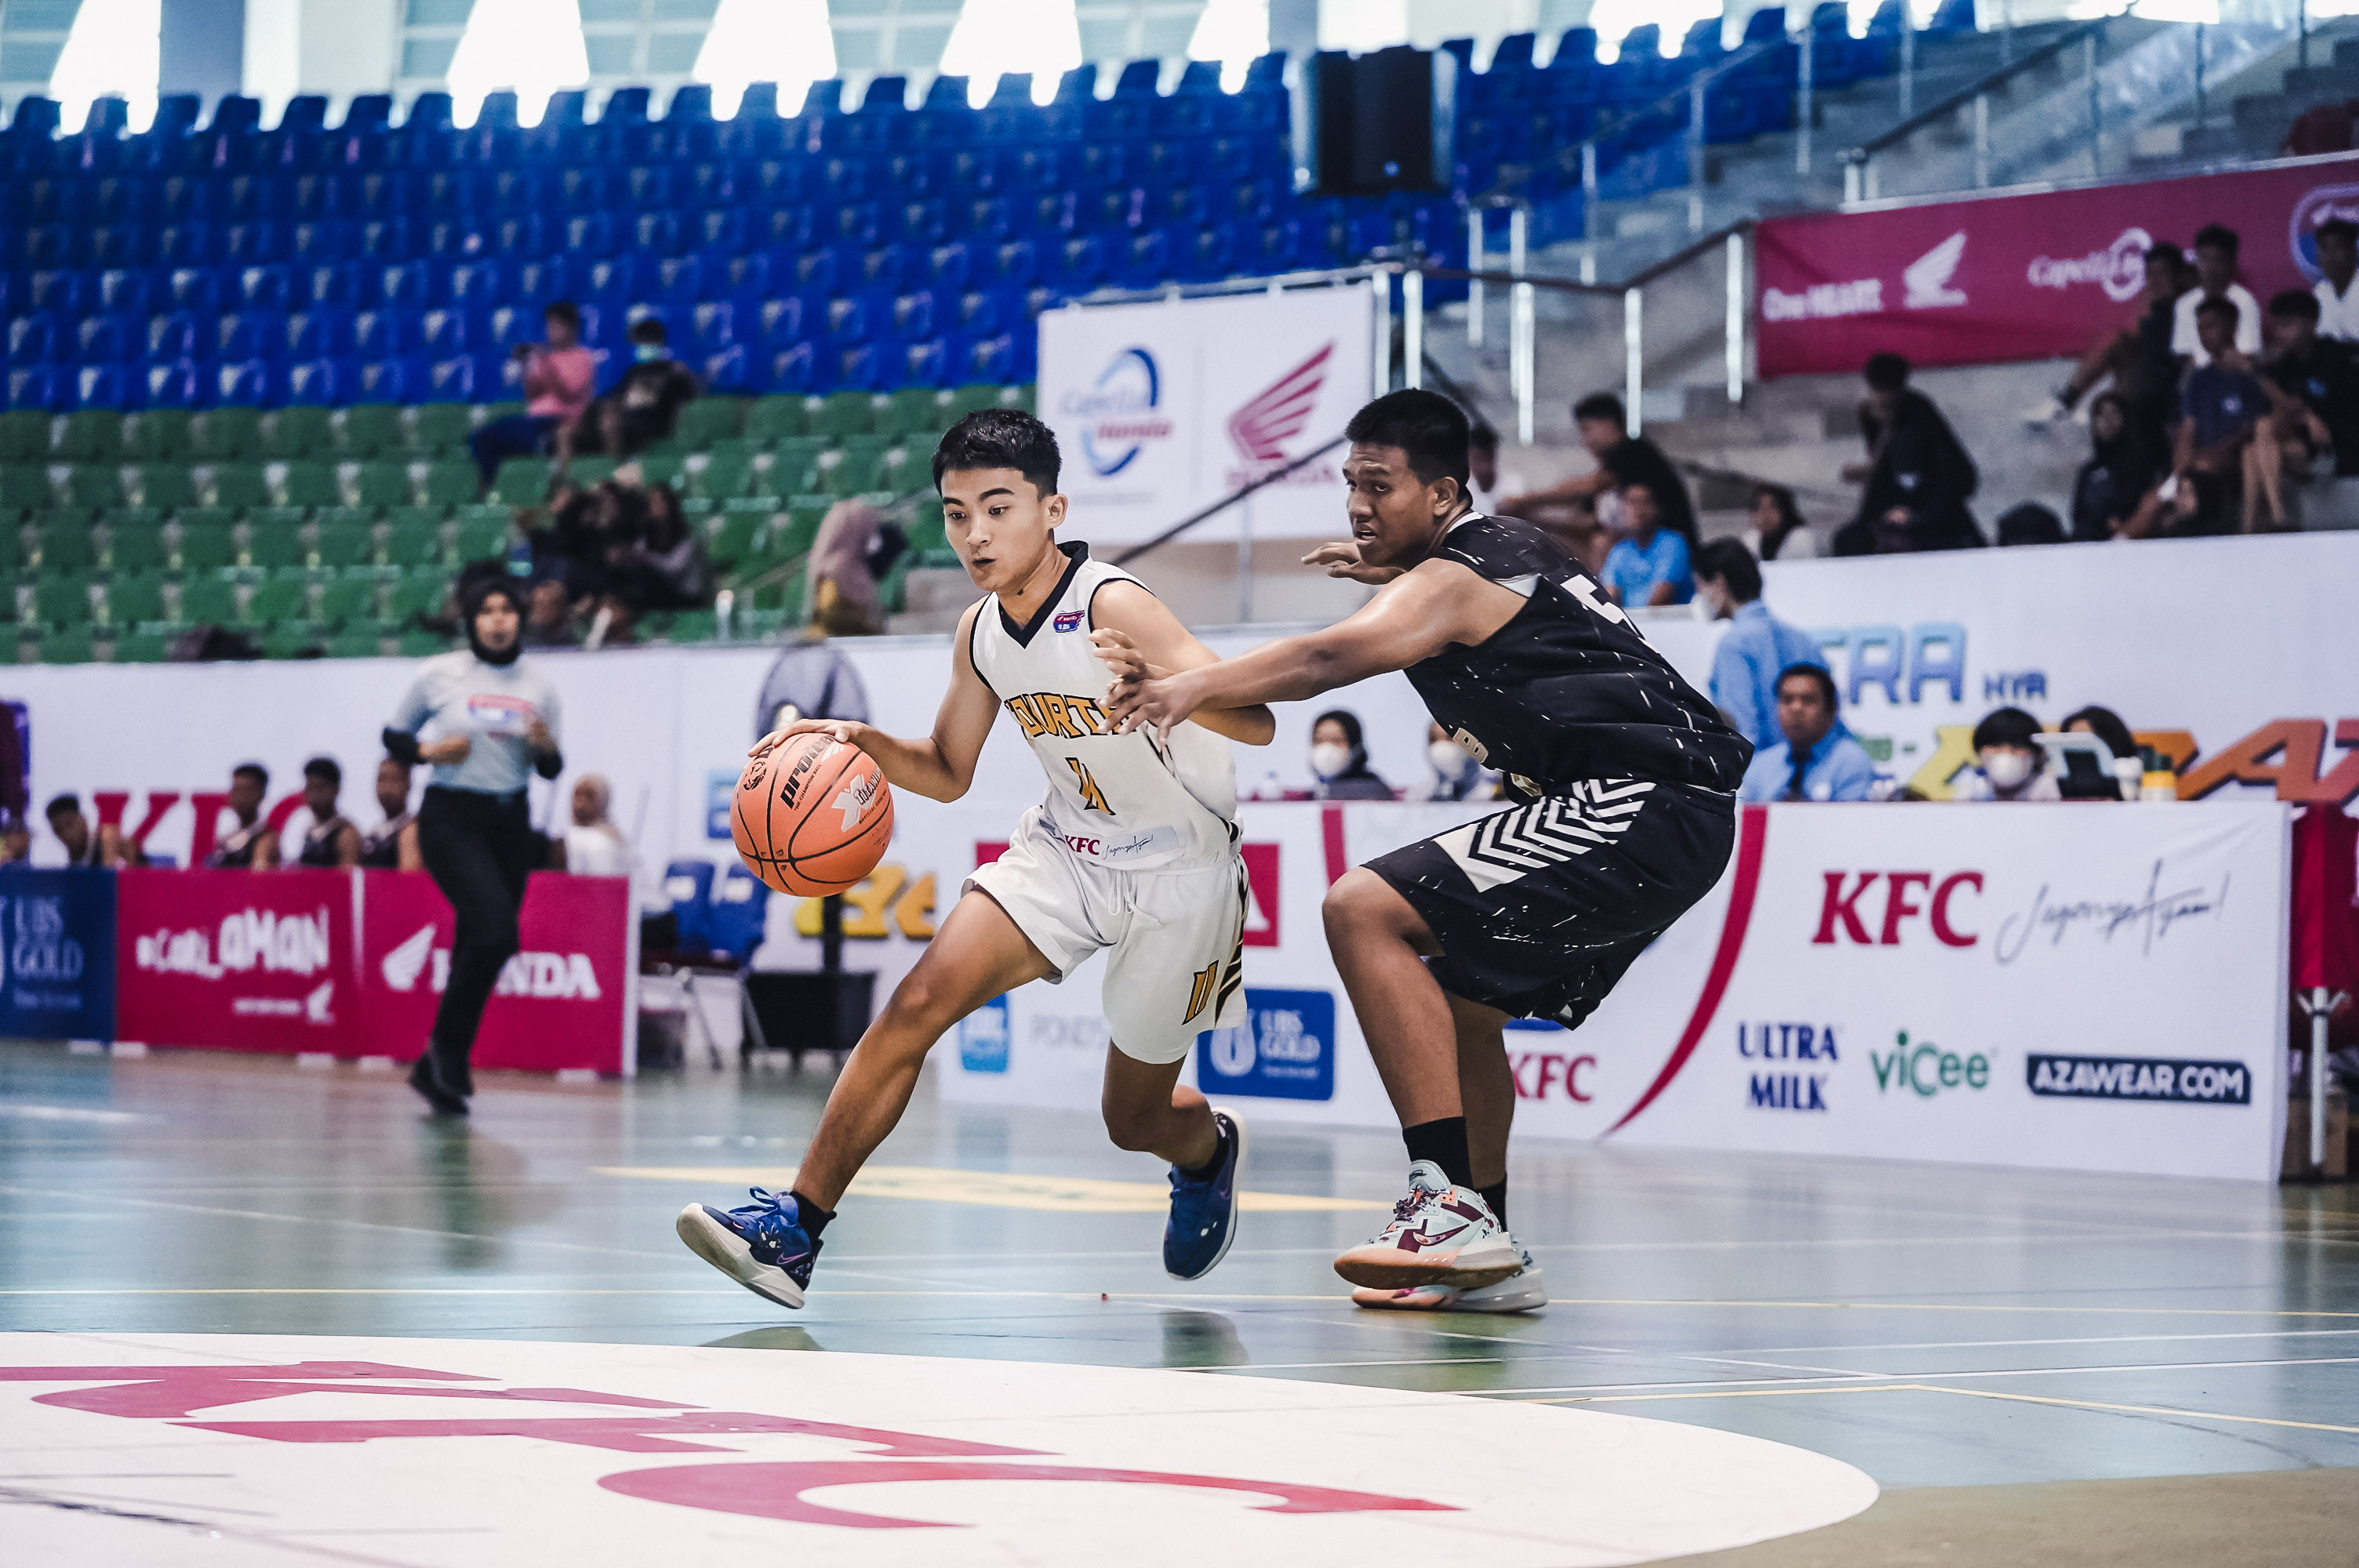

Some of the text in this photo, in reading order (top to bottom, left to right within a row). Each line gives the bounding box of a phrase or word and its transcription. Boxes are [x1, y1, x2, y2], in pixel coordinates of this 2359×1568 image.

[1064, 834, 1100, 855] KFC
[1812, 871, 1984, 948] KFC
[1739, 1022, 1839, 1062] ULTRA
[1747, 1072, 1829, 1112] MILK
[2033, 1061, 2246, 1099] AZAWEAR.COM
